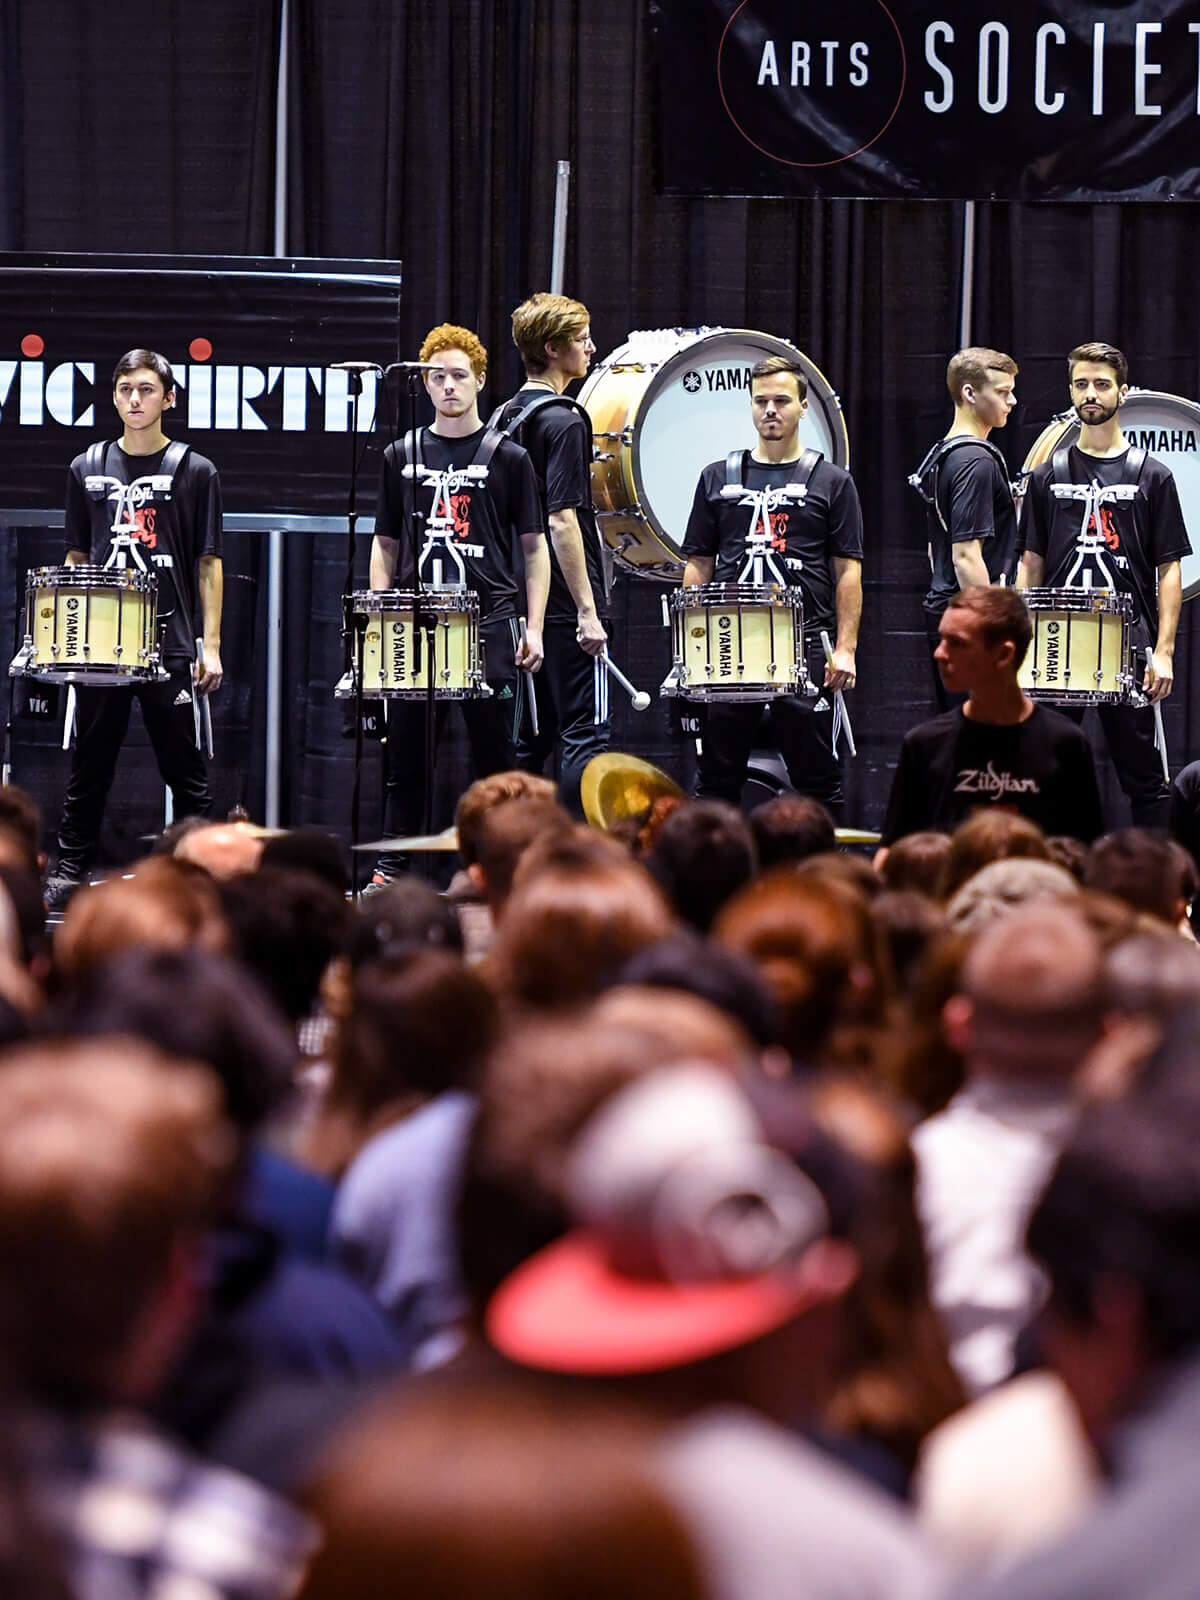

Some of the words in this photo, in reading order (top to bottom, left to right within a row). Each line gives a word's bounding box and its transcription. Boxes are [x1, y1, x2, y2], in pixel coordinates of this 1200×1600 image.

[757, 40, 869, 87] ARTS
[704, 367, 752, 392] YAMA
[1122, 430, 1197, 452] AMAHA
[66, 611, 79, 658] YAMAHA
[718, 630, 732, 677] YAMAHA
[392, 636, 406, 682] YAMAHA
[1046, 635, 1060, 682] YAMAHA
[953, 760, 1040, 800] Zildjian
